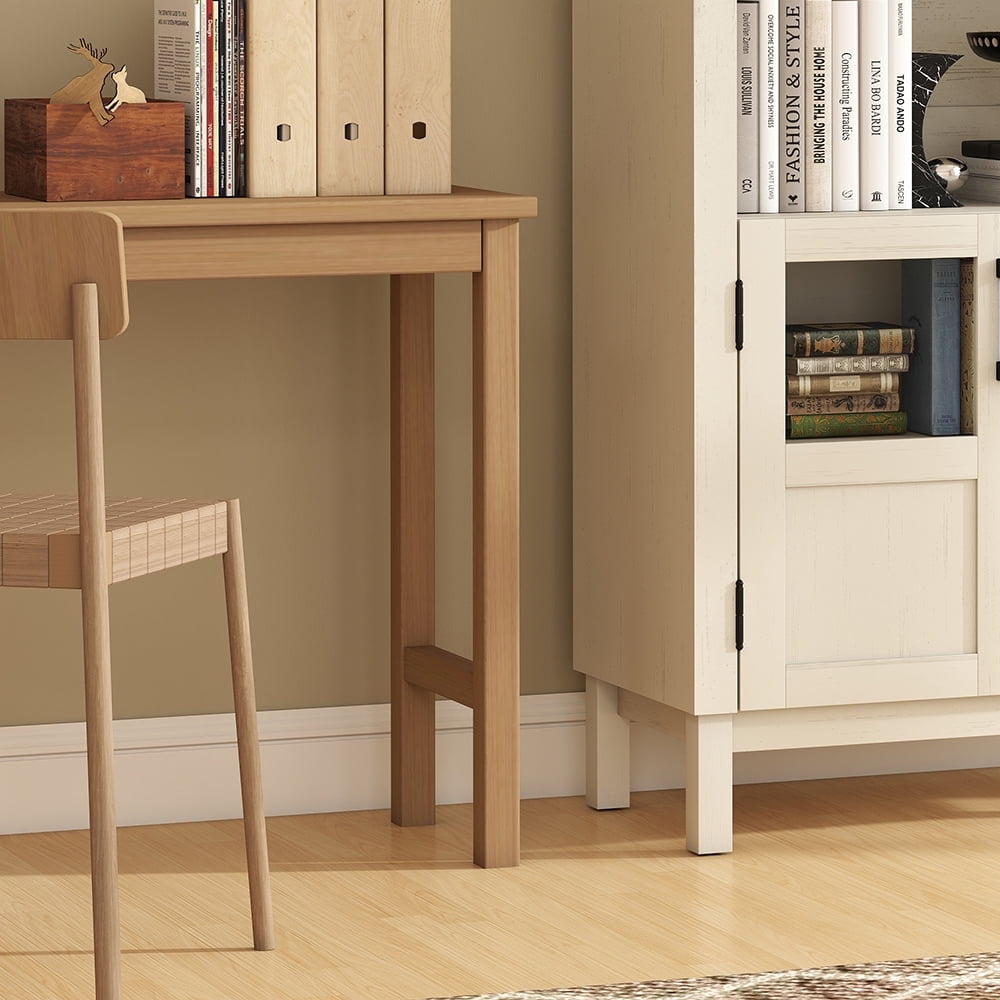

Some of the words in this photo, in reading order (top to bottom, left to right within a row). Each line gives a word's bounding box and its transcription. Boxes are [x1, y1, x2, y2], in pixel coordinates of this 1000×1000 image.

[742, 12, 751, 27] David
[742, 27, 751, 37] Van
[742, 37, 751, 55] Zanten
[785, 6, 800, 68] STYLE
[813, 47, 825, 71] HOME
[741, 66, 753, 86] LOUIS
[785, 73, 800, 88] &
[839, 52, 853, 105] Constructing
[870, 60, 881, 85] LINA
[813, 73, 825, 101] HOUSE
[870, 87, 881, 102] BO
[896, 74, 905, 105] TADAO
[741, 86, 753, 116] SULLIVAN
[813, 103, 825, 120] THE
[841, 106, 853, 141] Paradies
[870, 104, 881, 136] BARDI
[896, 107, 905, 133] ANDO
[785, 95, 800, 184] FASHION
[813, 122, 825, 164] BRINGING
